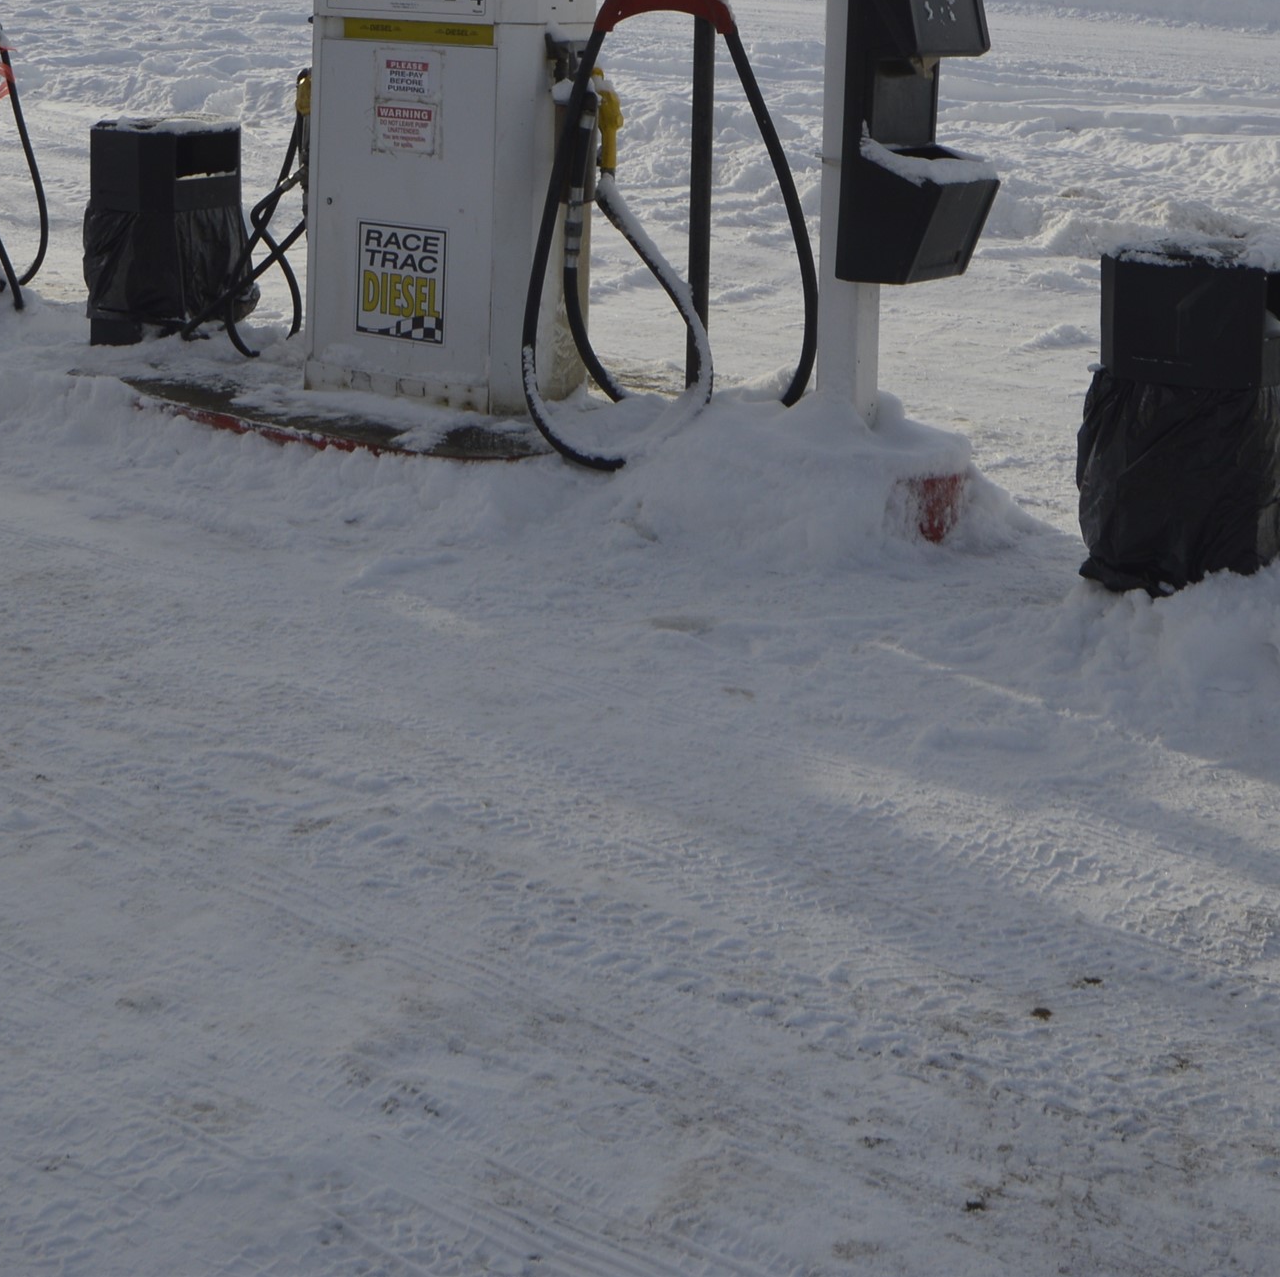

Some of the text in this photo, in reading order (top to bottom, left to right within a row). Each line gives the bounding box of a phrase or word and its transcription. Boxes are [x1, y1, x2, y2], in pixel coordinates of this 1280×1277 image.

[369, 24, 392, 32] DIESEL
[445, 28, 469, 36] DIESEL
[390, 61, 424, 71] PLEASE
[389, 70, 424, 79] PRE-PAY
[389, 77, 423, 86] BEFORE
[387, 85, 425, 94] PUMPING
[380, 108, 429, 120] WARNING
[365, 229, 441, 255] RACE
[365, 248, 439, 275] TRAC
[362, 269, 441, 319] DIESEL
